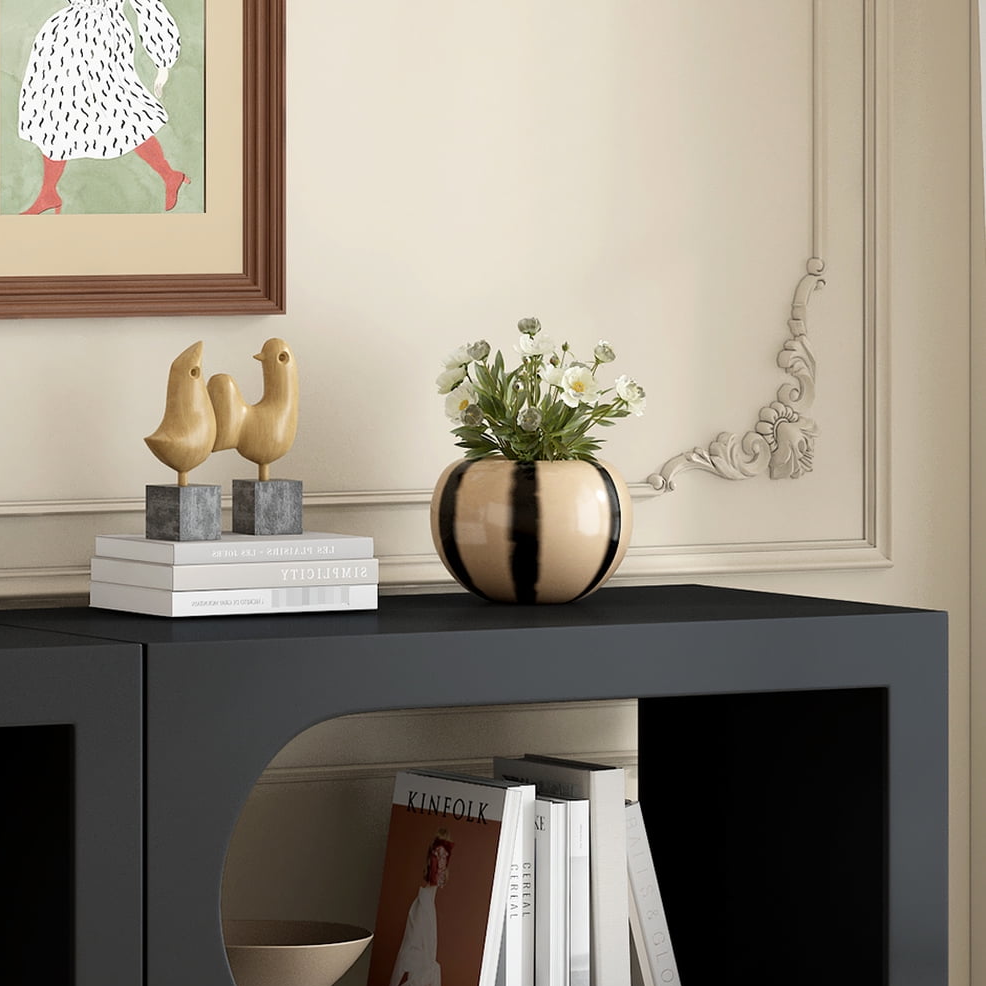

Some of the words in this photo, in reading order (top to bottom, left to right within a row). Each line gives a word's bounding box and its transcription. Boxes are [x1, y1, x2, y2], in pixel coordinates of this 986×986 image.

[406, 791, 489, 825] KINFOLK
[510, 864, 519, 919] CEREAL
[522, 862, 532, 917] CEREAL
